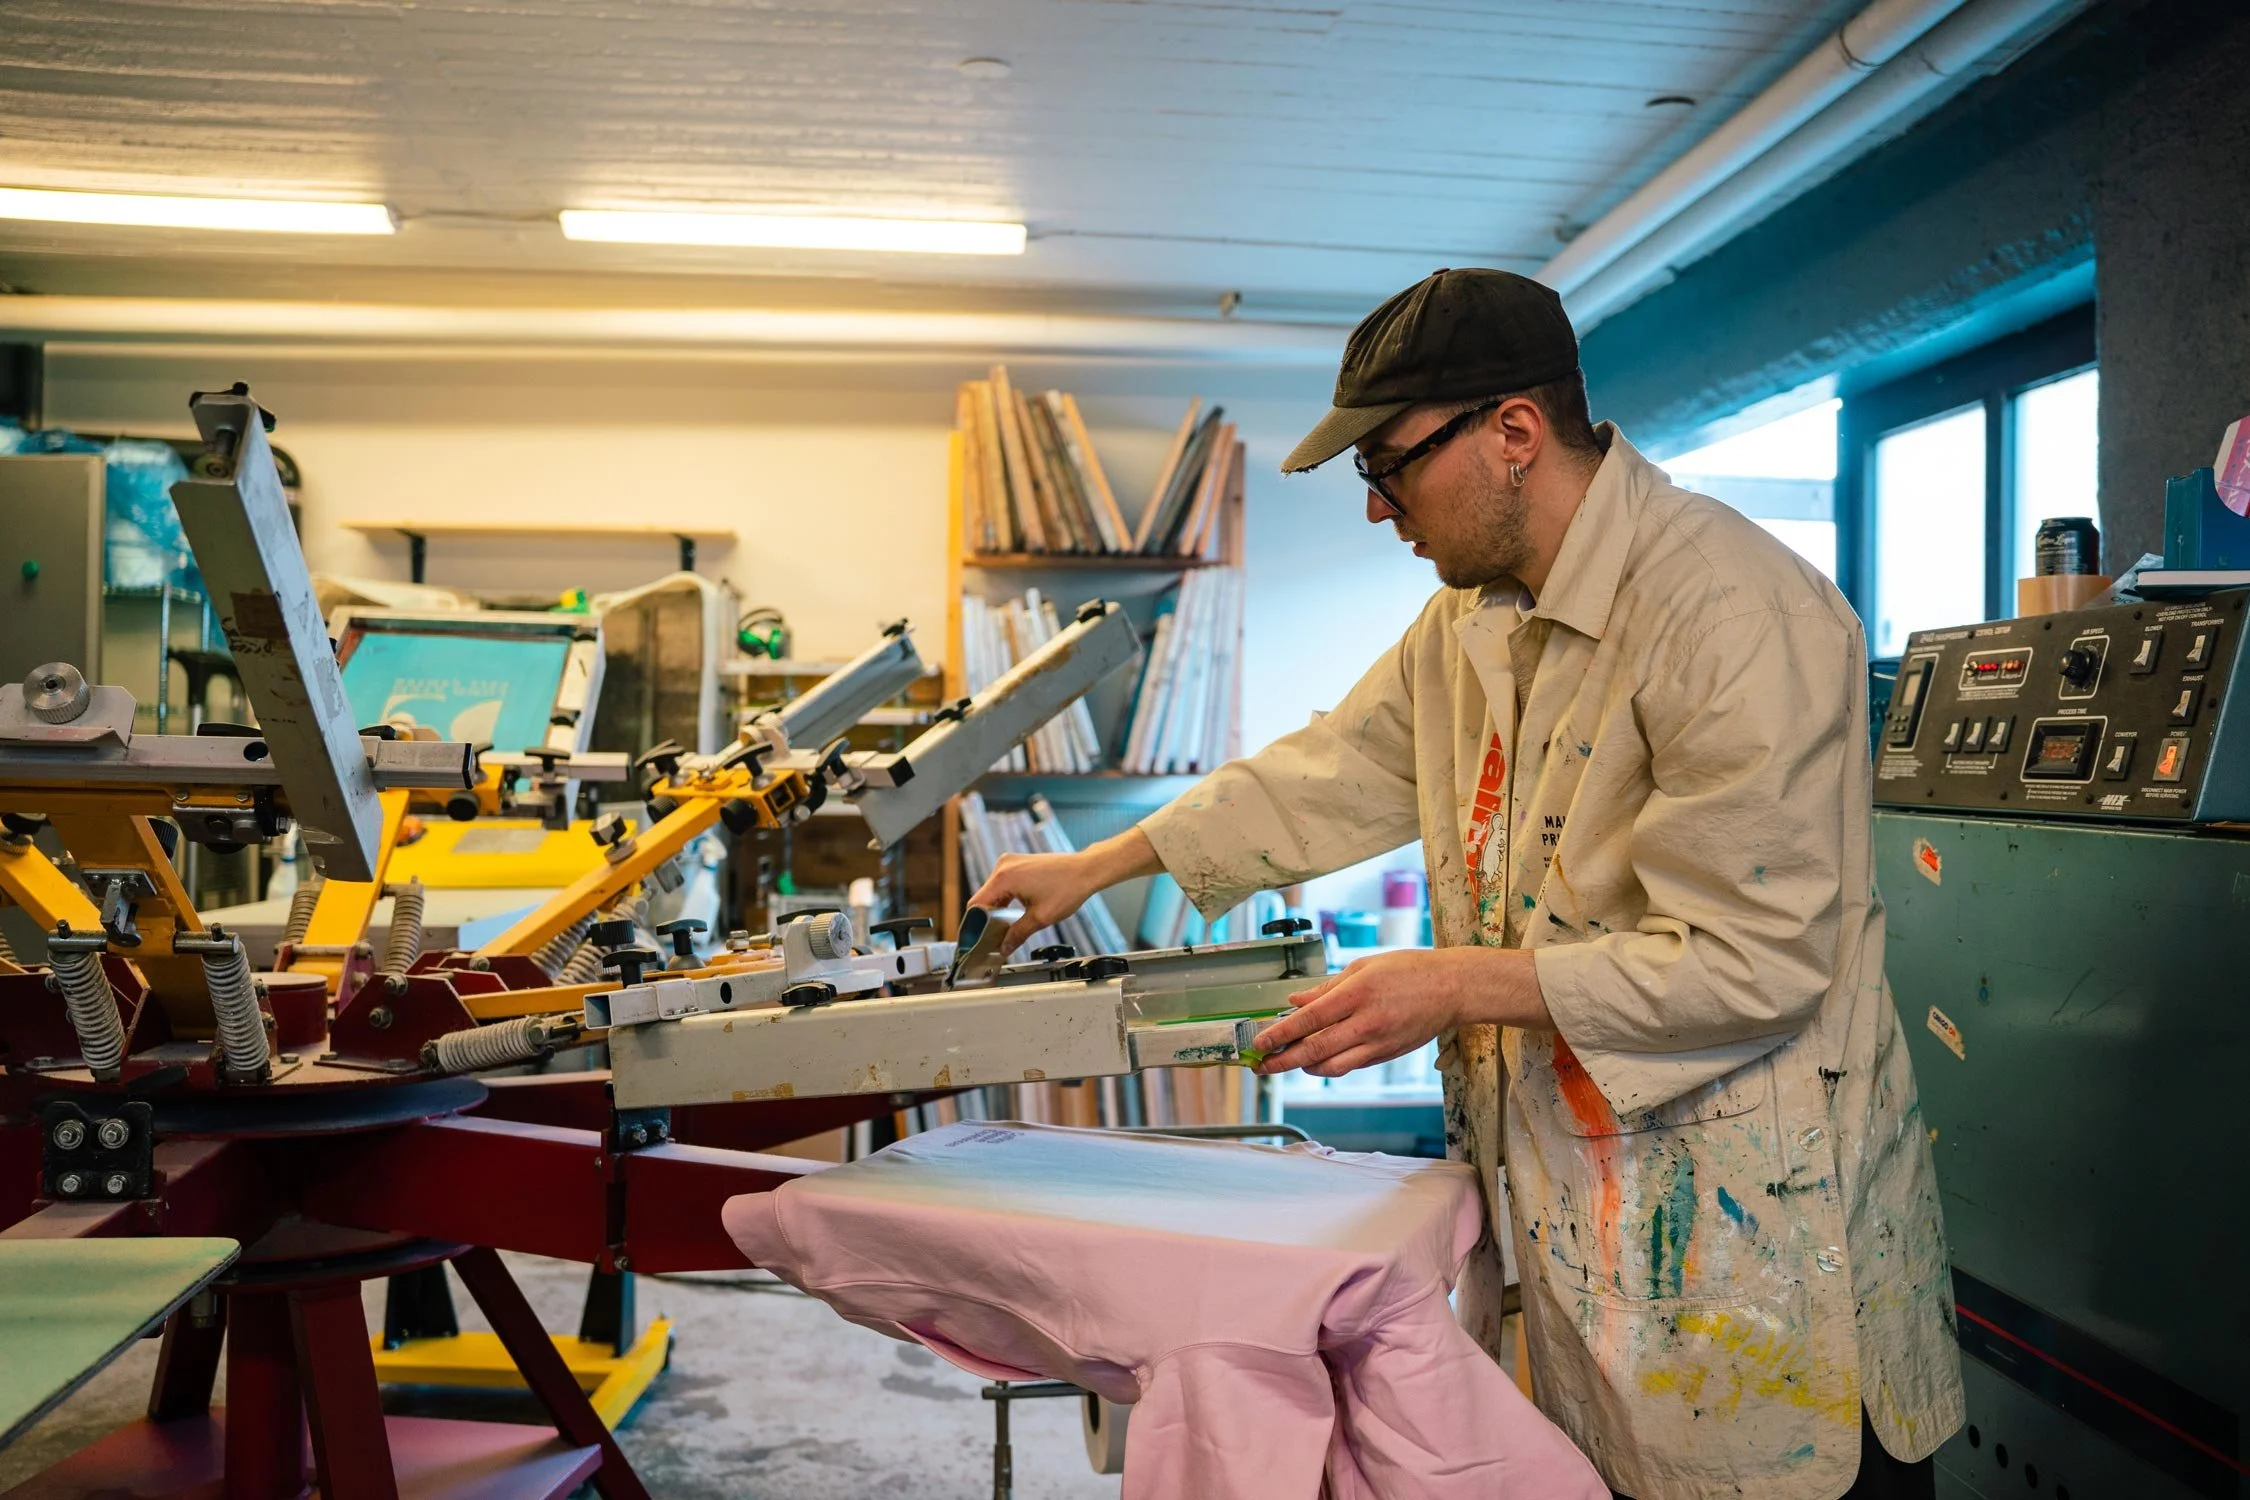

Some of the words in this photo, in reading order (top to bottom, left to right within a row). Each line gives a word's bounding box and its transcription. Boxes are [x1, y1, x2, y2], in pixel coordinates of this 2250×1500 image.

[2191, 618, 2225, 627] TRANSFORMER
[2090, 627, 2105, 635] SPEED
[2182, 674, 2204, 682] EXHAUST
